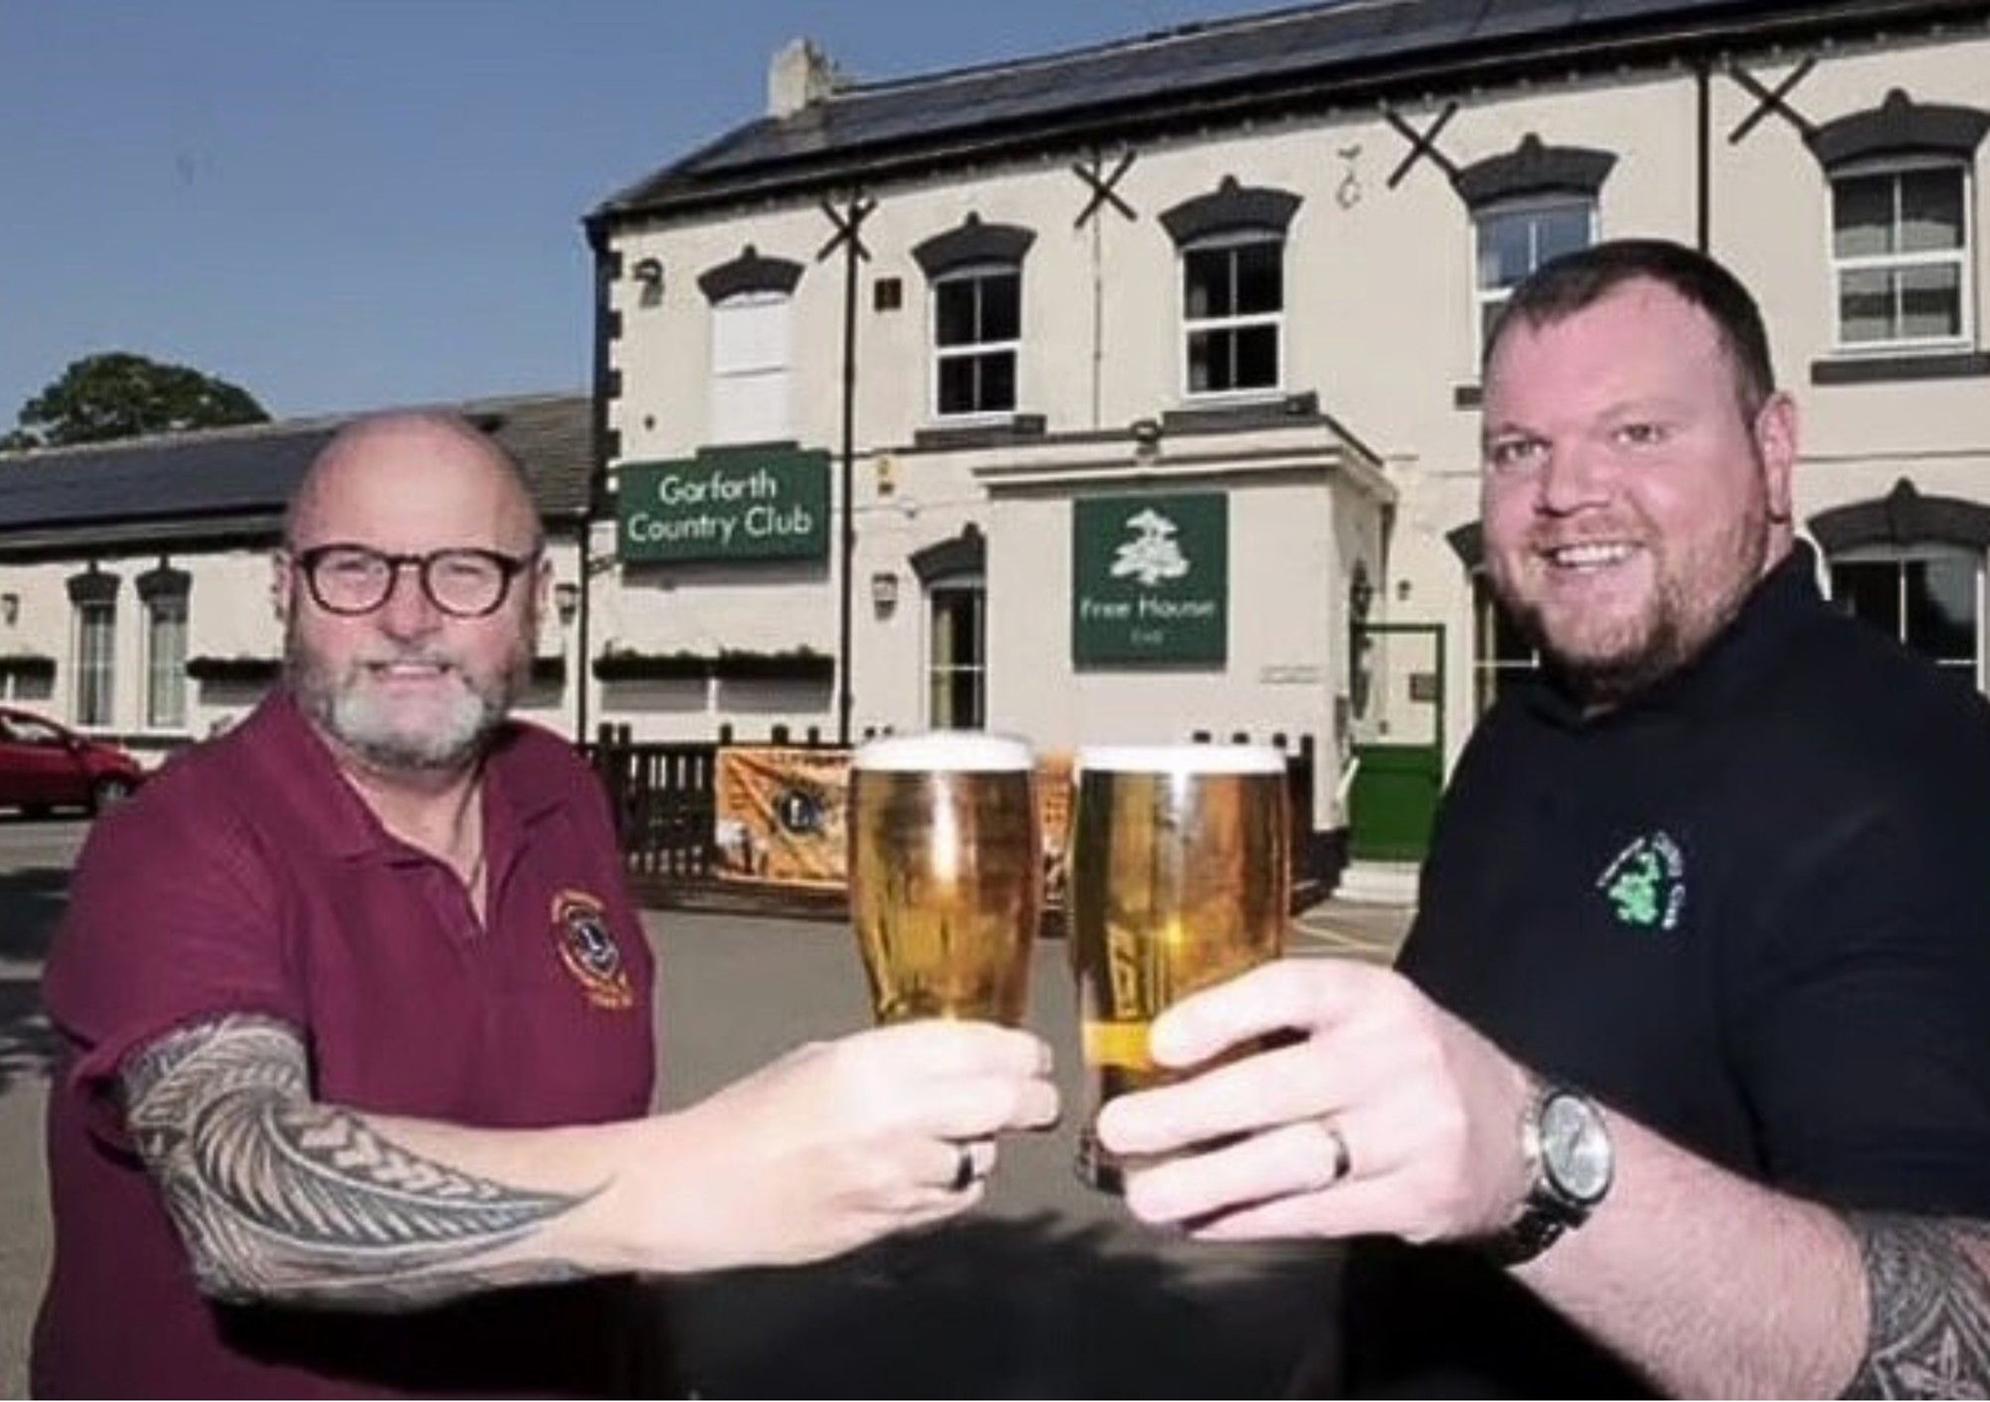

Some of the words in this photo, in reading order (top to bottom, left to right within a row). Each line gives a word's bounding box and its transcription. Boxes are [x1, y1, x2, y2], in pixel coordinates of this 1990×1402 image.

[658, 467, 778, 505] Garforth
[627, 512, 737, 546] Country
[744, 503, 813, 537] Club
[1079, 597, 1132, 621] Free
[1138, 594, 1215, 619] House
